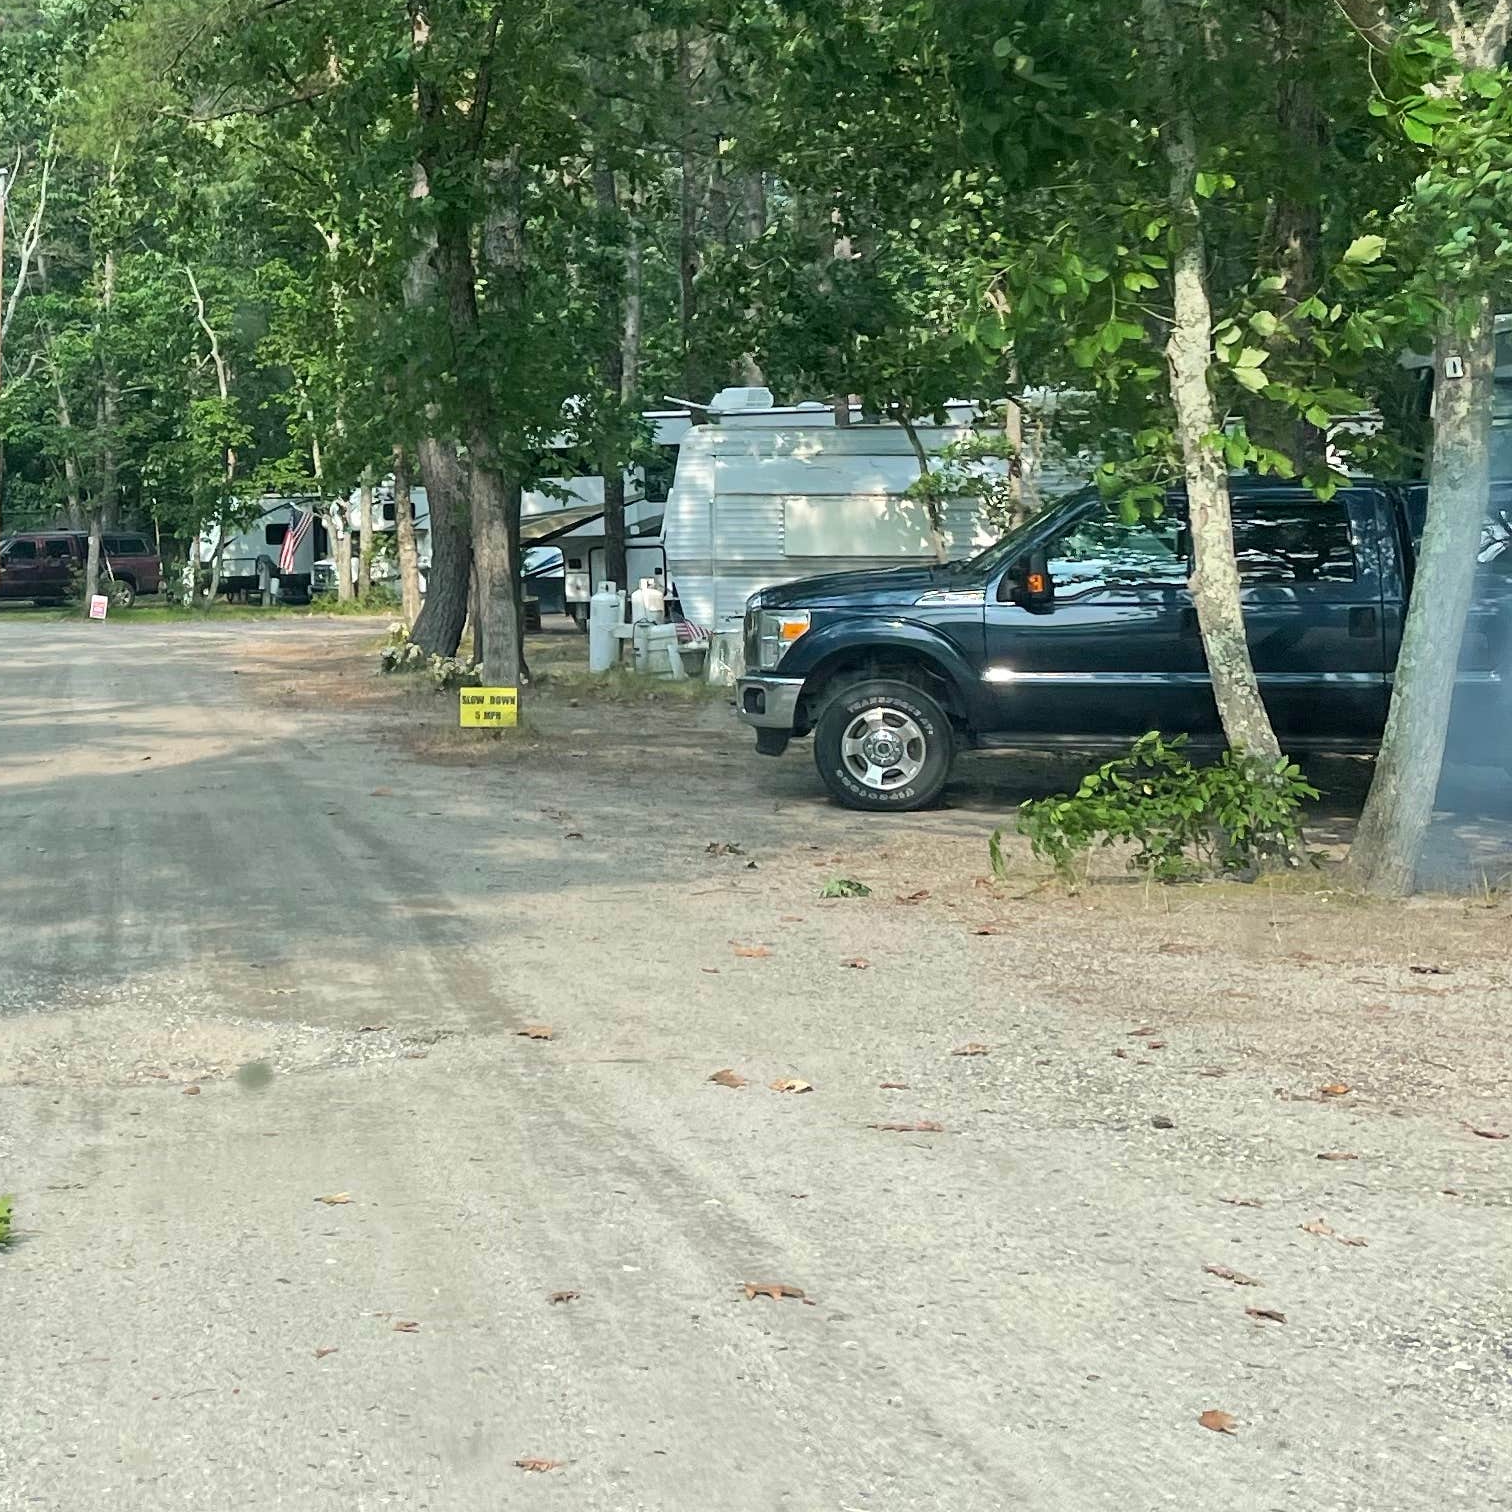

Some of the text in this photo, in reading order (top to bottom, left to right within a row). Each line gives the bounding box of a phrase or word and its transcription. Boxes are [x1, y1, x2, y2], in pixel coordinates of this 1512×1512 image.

[462, 695, 516, 705] SLOW DOWN
[474, 710, 501, 720] 5 MPH
